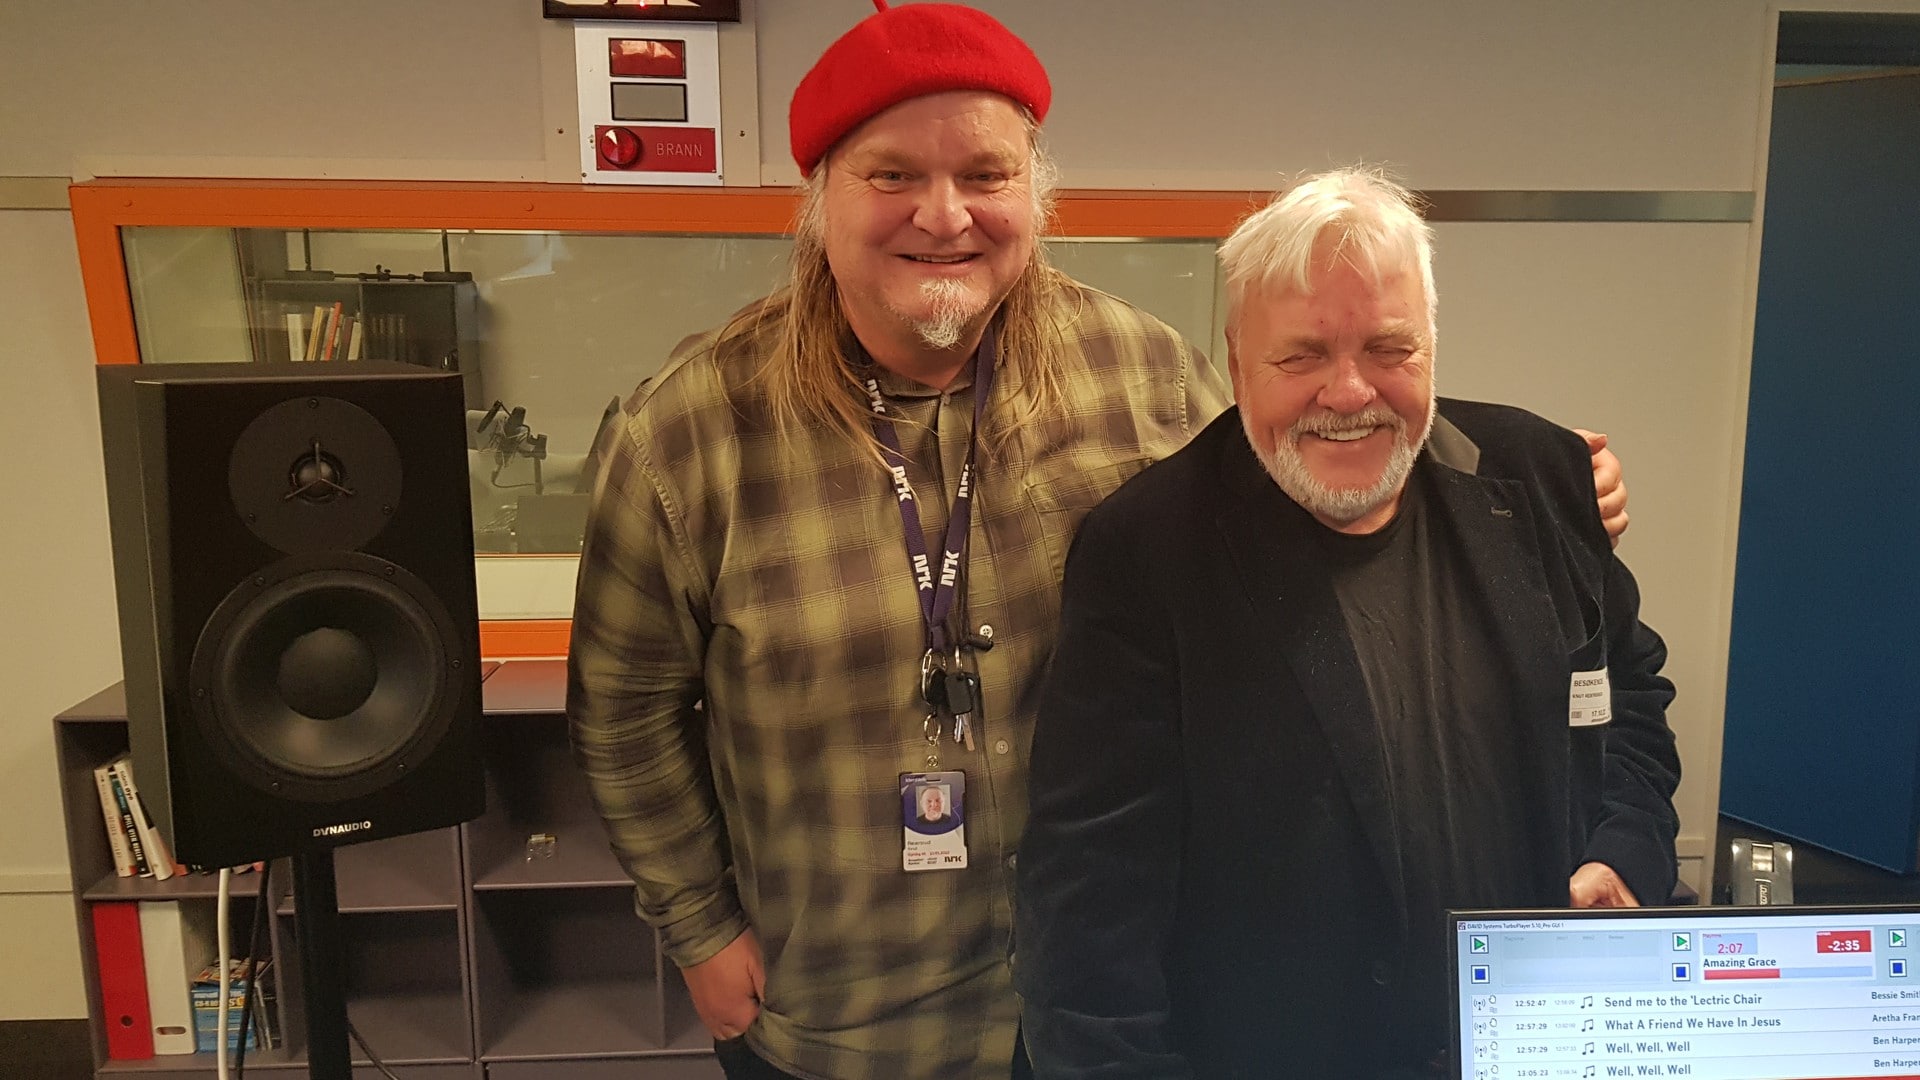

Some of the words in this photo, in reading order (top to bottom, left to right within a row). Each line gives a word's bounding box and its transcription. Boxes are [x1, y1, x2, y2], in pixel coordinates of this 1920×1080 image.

[656, 142, 702, 157] BRANN
[892, 466, 913, 501] NRK
[913, 554, 933, 591] NRK
[941, 550, 960, 586] NRK
[313, 820, 371, 837] DYNAUDIO
[944, 855, 962, 863] NRK
[1503, 922, 1531, 930] TurboPlayer
[1718, 943, 1743, 954] 2:07
[1828, 940, 1860, 951] -2:35
[1703, 957, 1746, 968] Amazing
[1748, 957, 1777, 967] Grace
[1604, 997, 1632, 1007] Send
[1636, 999, 1652, 1007] me
[1656, 996, 1667, 1006] to
[1670, 995, 1687, 1006] the
[1690, 994, 1730, 1005] 'Lectric
[1733, 993, 1762, 1004] Chair
[1871, 991, 1898, 999] Bessie
[1605, 1020, 1633, 1030] What
[1637, 1019, 1645, 1030] A
[1648, 1018, 1683, 1030] Friend
[1686, 1018, 1704, 1028] We
[1707, 1017, 1734, 1028] Have
[1737, 1016, 1747, 1027] In
[1750, 1016, 1781, 1027] Jesus
[1872, 1013, 1901, 1022] Aretha
[1873, 1036, 1890, 1045] Ben
[1606, 1042, 1633, 1054] Well,
[1636, 1042, 1663, 1053] Well,
[1666, 1041, 1691, 1052] Well
[1874, 1059, 1891, 1068] Ben
[1606, 1065, 1634, 1077] Well,
[1637, 1065, 1664, 1076] Well,
[1667, 1064, 1691, 1075] Well
